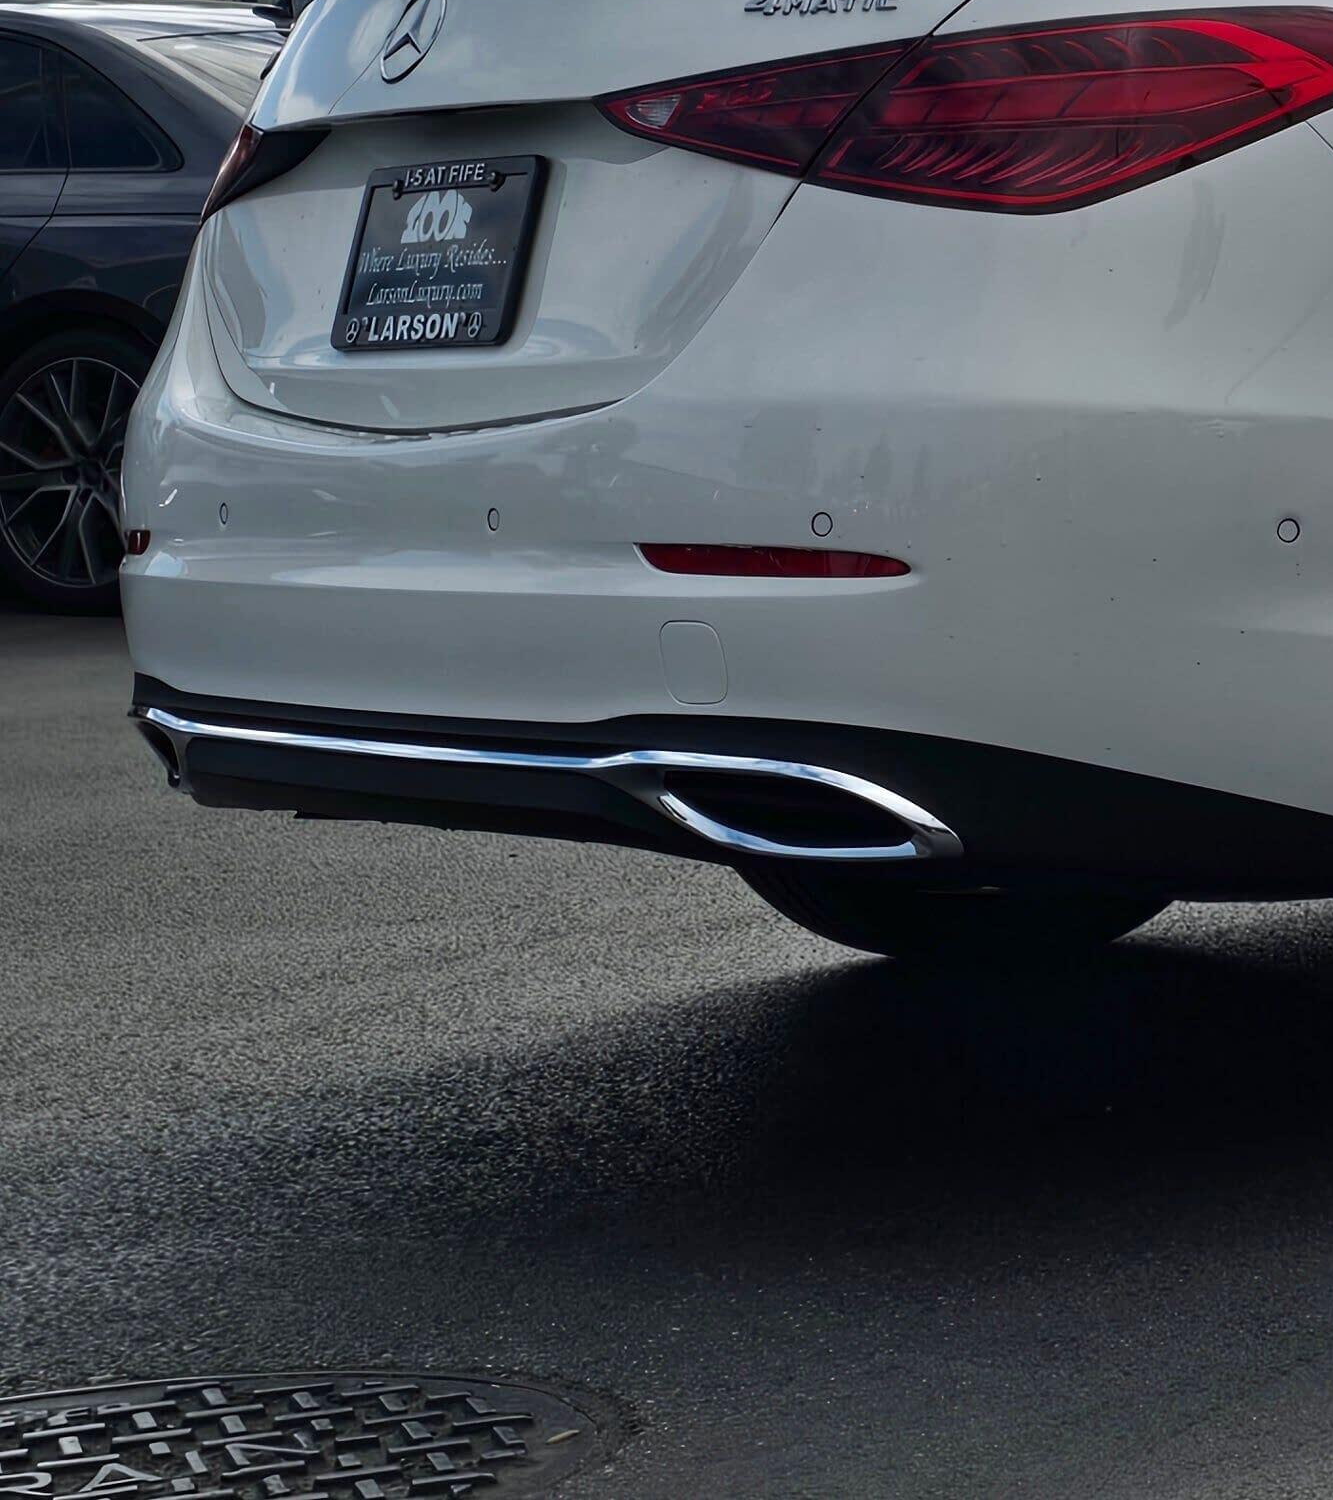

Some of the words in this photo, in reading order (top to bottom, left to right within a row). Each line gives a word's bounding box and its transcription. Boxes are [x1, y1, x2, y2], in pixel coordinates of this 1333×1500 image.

[423, 165, 446, 186] AT
[449, 163, 485, 183] FIFE
[359, 246, 393, 274] Where
[395, 247, 442, 280] Luxury
[366, 280, 484, 309] LarsonLuxury.com
